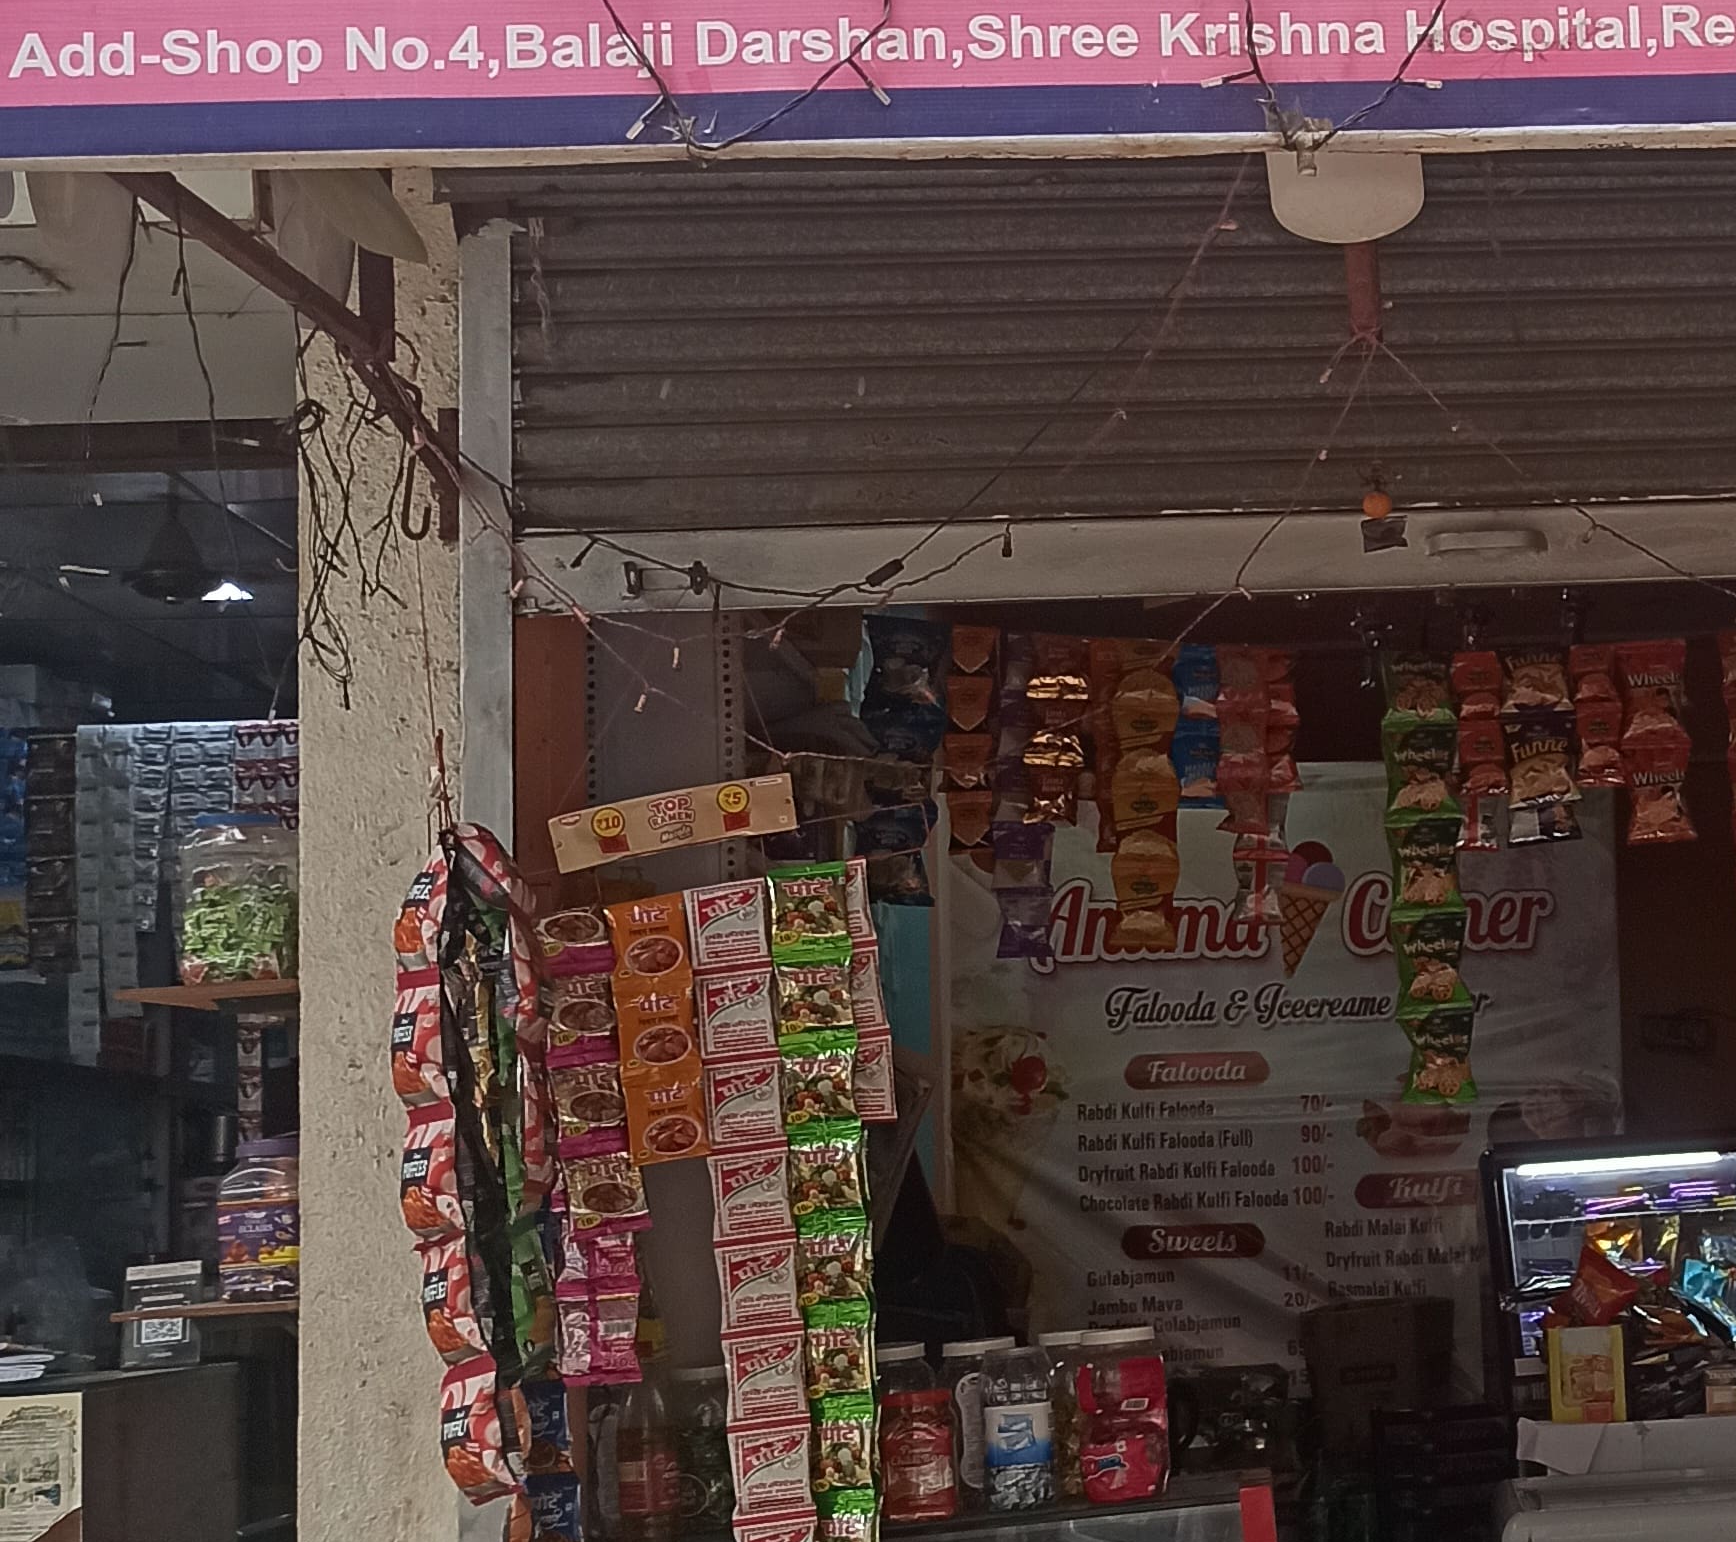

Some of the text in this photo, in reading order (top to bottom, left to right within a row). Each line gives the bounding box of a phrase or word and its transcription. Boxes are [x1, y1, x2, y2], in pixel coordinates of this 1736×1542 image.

[8, 30, 324, 85] Add-Shop
[1160, 8, 1388, 60] Krishna
[650, 796, 690, 815] TOP
[1224, 990, 1248, 1019] &
[1148, 1060, 1247, 1083] Falooda
[1078, 1103, 1117, 1121] Rabdi
[1122, 1102, 1155, 1119] Kulfi
[1160, 1100, 1214, 1117] Falooda
[1078, 1134, 1117, 1152] Rabdi
[1122, 1133, 1155, 1150] Kulfi
[1160, 1131, 1214, 1149] Falooda
[1219, 1129, 1253, 1149] (Full)
[1078, 1164, 1135, 1186] Dryfruit
[1140, 1162, 1178, 1180] Rabdi
[1221, 1160, 1275, 1177] Falooda
[1080, 1194, 1149, 1213] Chocolate
[1154, 1192, 1193, 1210] Rabdi
[1198, 1191, 1230, 1209] Kulfi
[1235, 1190, 1288, 1208] Falooda
[1325, 1219, 1363, 1238] Rabdi
[1367, 1218, 1406, 1237] Malai
[1149, 1228, 1238, 1254] Sweets
[1087, 1269, 1176, 1289] Gulabjamun
